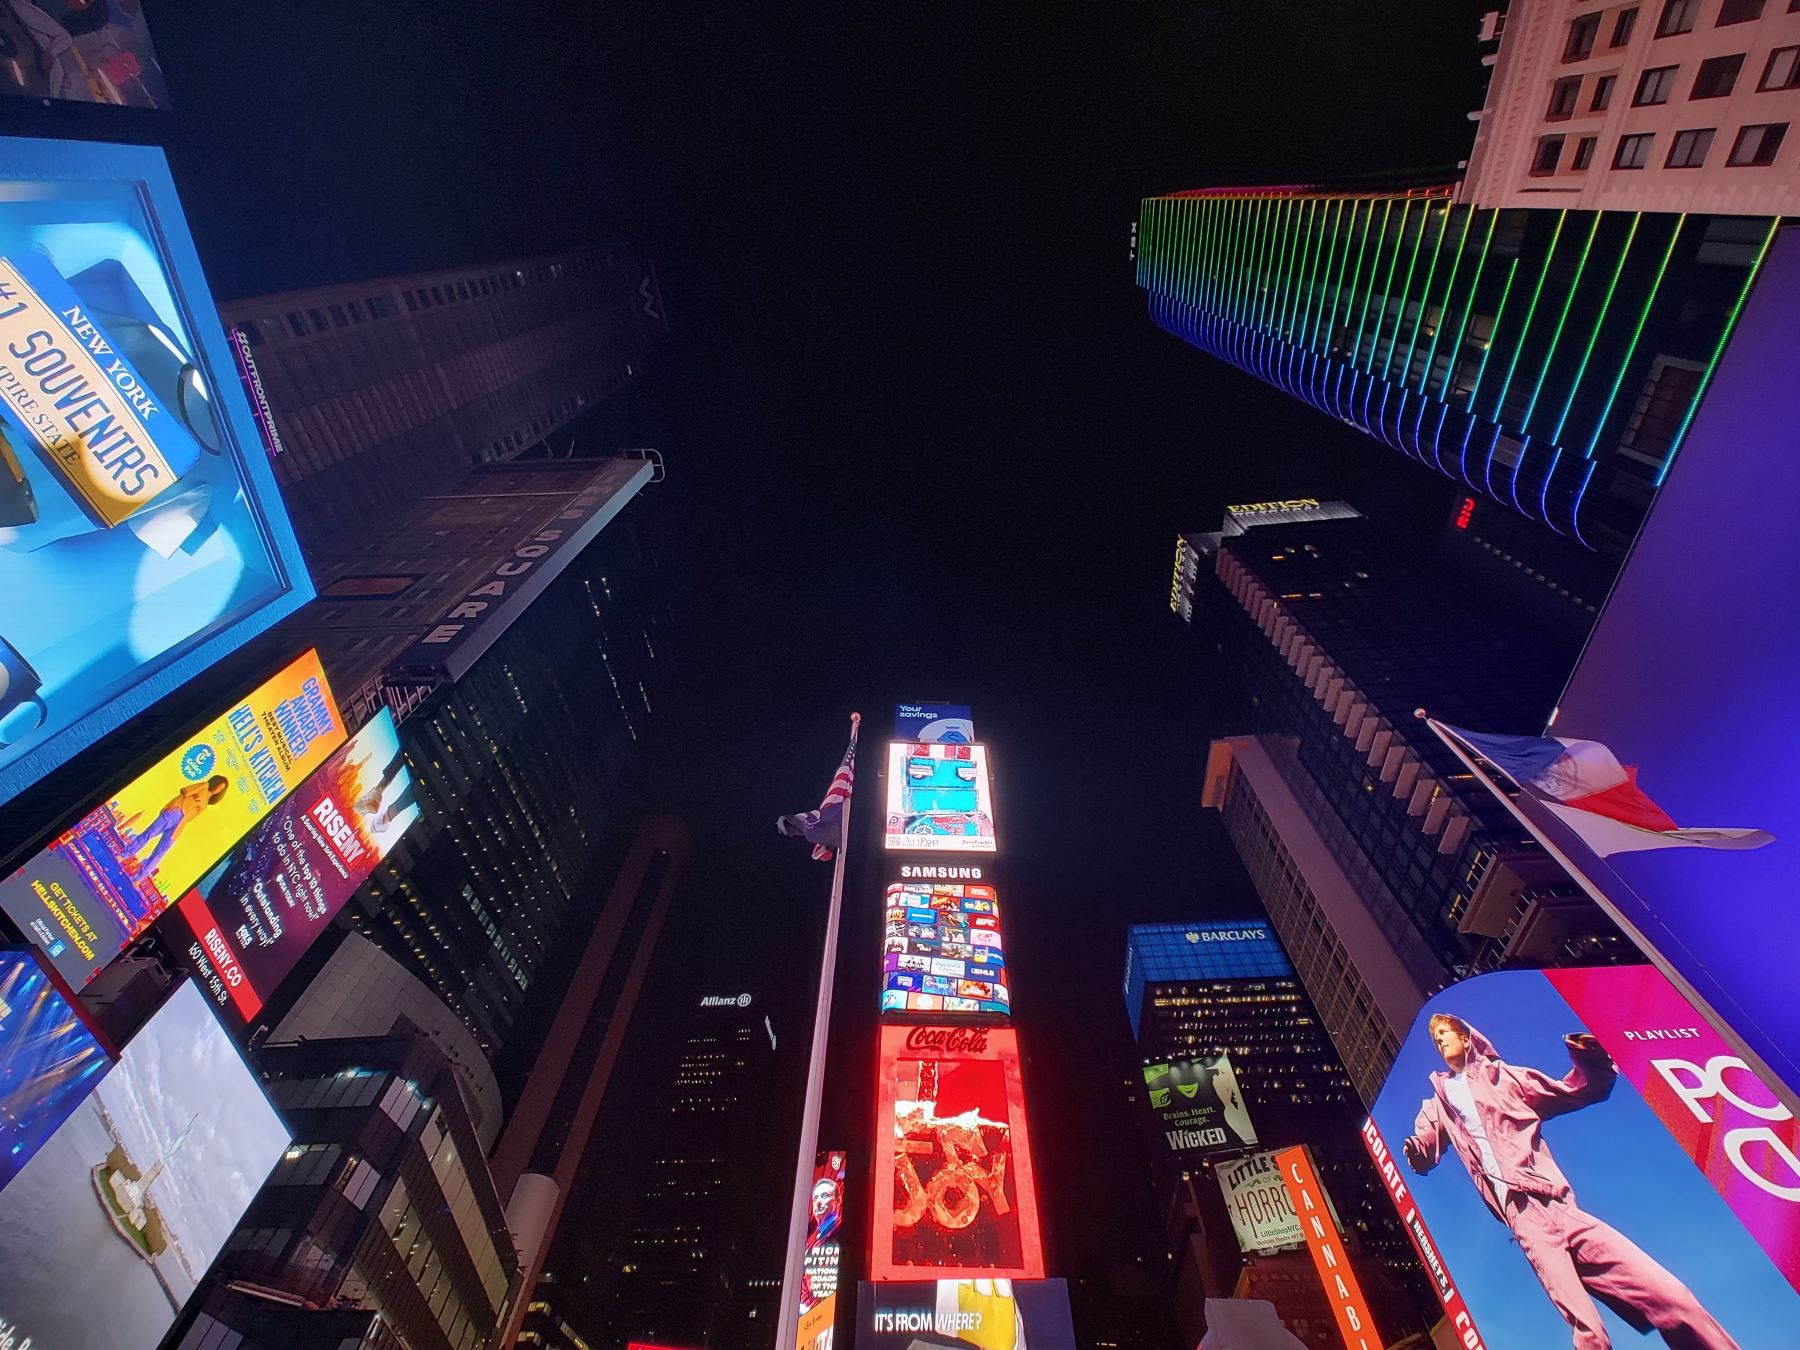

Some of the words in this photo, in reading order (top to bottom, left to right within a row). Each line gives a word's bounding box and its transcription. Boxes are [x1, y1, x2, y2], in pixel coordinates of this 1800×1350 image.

[62, 305, 114, 357] NEW
[106, 357, 160, 421] YORK
[8, 329, 160, 497] SOUVENIRS
[32, 412, 81, 466] STATE
[1227, 498, 1320, 514] EDITION
[421, 529, 564, 644] SQUARE
[273, 699, 309, 760] WINNER!
[289, 695, 319, 744] AWARD
[302, 676, 334, 737] GRAMMY
[900, 711, 938, 720] savings
[227, 703, 264, 753] HELL'S
[248, 745, 287, 805] KITCHEN
[261, 710, 278, 747] THEATER
[276, 745, 291, 772] ALBUM
[267, 711, 280, 732] BEST
[276, 730, 293, 765] MUSICAL
[272, 832, 281, 844] to
[277, 842, 287, 857] do
[286, 863, 301, 884] NYC
[295, 881, 311, 906] right
[901, 866, 983, 879] SAMSUNG
[30, 879, 96, 961] HELLSKITCHEN.COM
[50, 882, 67, 901] GET
[62, 898, 91, 933] TICKETS
[86, 931, 98, 942] AT
[244, 903, 260, 930] every
[311, 884, 327, 914] things
[203, 928, 242, 987] RISENY.CO
[1202, 929, 1265, 942] BARCLAYS
[188, 941, 202, 960] 160
[196, 954, 212, 978] West
[217, 990, 229, 1006] St.
[700, 996, 737, 1007] Allianz
[1623, 1027, 1701, 1041] PLAYLIST
[1163, 1110, 1191, 1121] Brains.
[1191, 1106, 1217, 1117] Heart.
[1174, 1116, 1210, 1127] Courage.
[1227, 1156, 1271, 1191] LITTLE
[1413, 1218, 1450, 1289] HERSHEY'S
[810, 1282, 822, 1290] OF
[874, 1313, 894, 1332] IT'S
[895, 1313, 933, 1332] FROM
[935, 1312, 984, 1331] WHERE?
